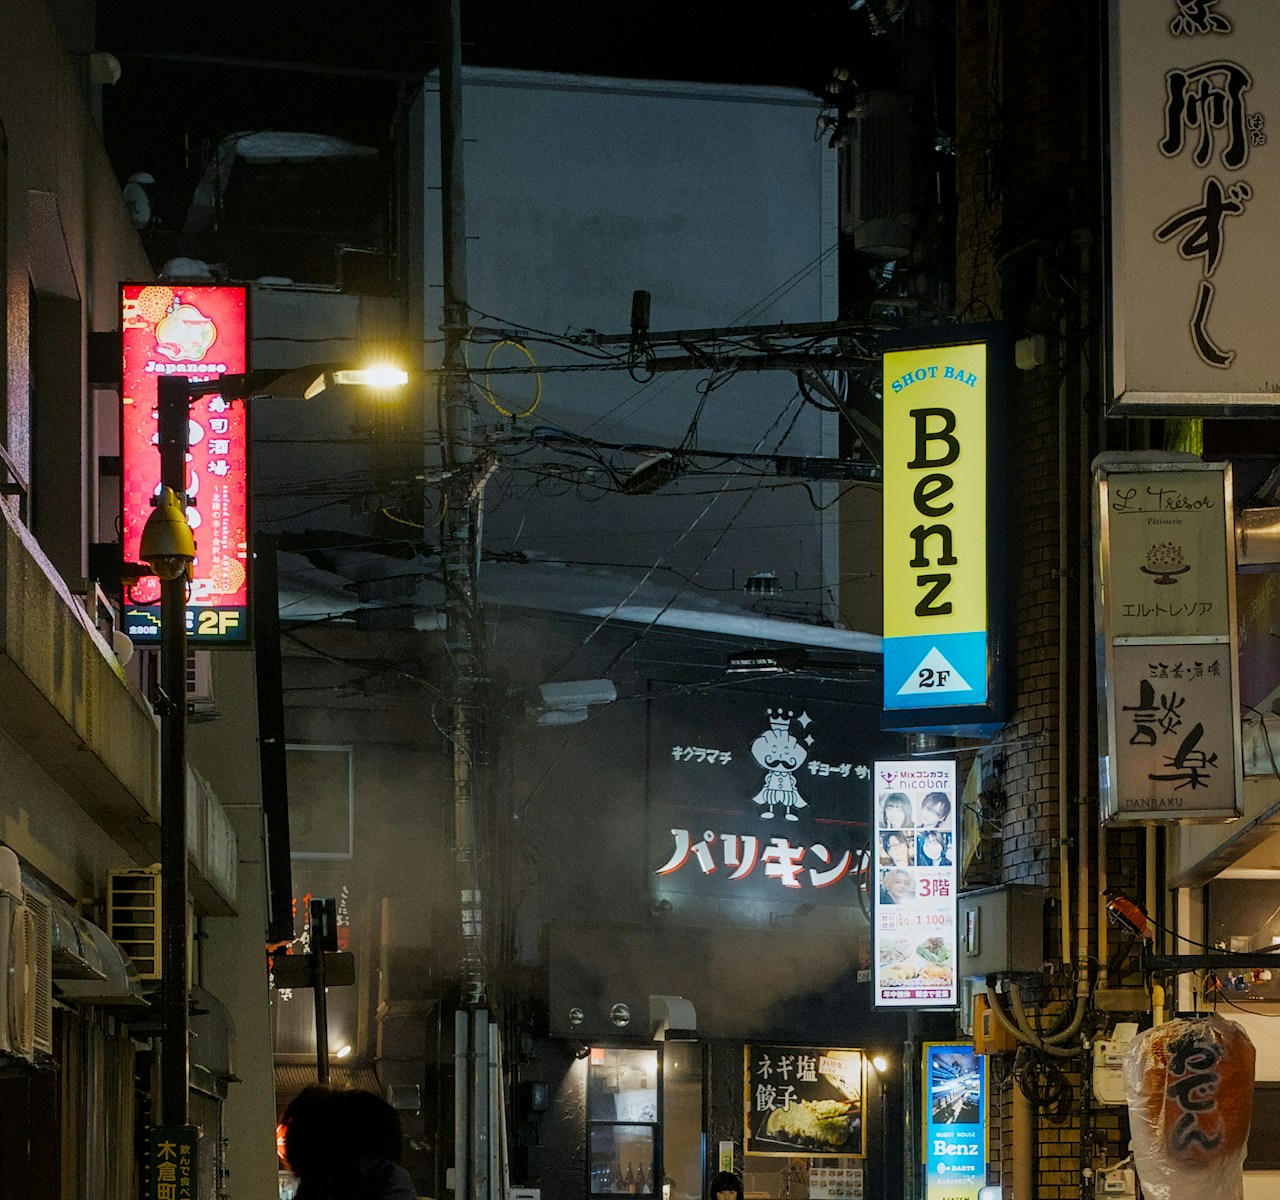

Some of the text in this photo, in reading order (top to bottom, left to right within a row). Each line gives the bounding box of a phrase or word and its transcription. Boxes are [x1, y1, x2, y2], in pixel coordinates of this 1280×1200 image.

[144, 361, 227, 375] Japanese
[891, 366, 977, 394] SHOT BAR
[1147, 486, 1216, 511] Trésor
[907, 407, 961, 617] Benz
[198, 610, 240, 635] 2F
[919, 668, 951, 688] 2F
[671, 745, 733, 766] キグラマチ
[807, 760, 853, 779] ギョーザ
[899, 780, 948, 790] nicobar
[1125, 796, 1184, 808] DANRAKU
[919, 879, 950, 898] 3階
[756, 1054, 818, 1083] ネギ塩
[755, 1083, 799, 1113] 餃子
[1166, 1031, 1224, 1152] おでん
[933, 1140, 979, 1156] Benz
